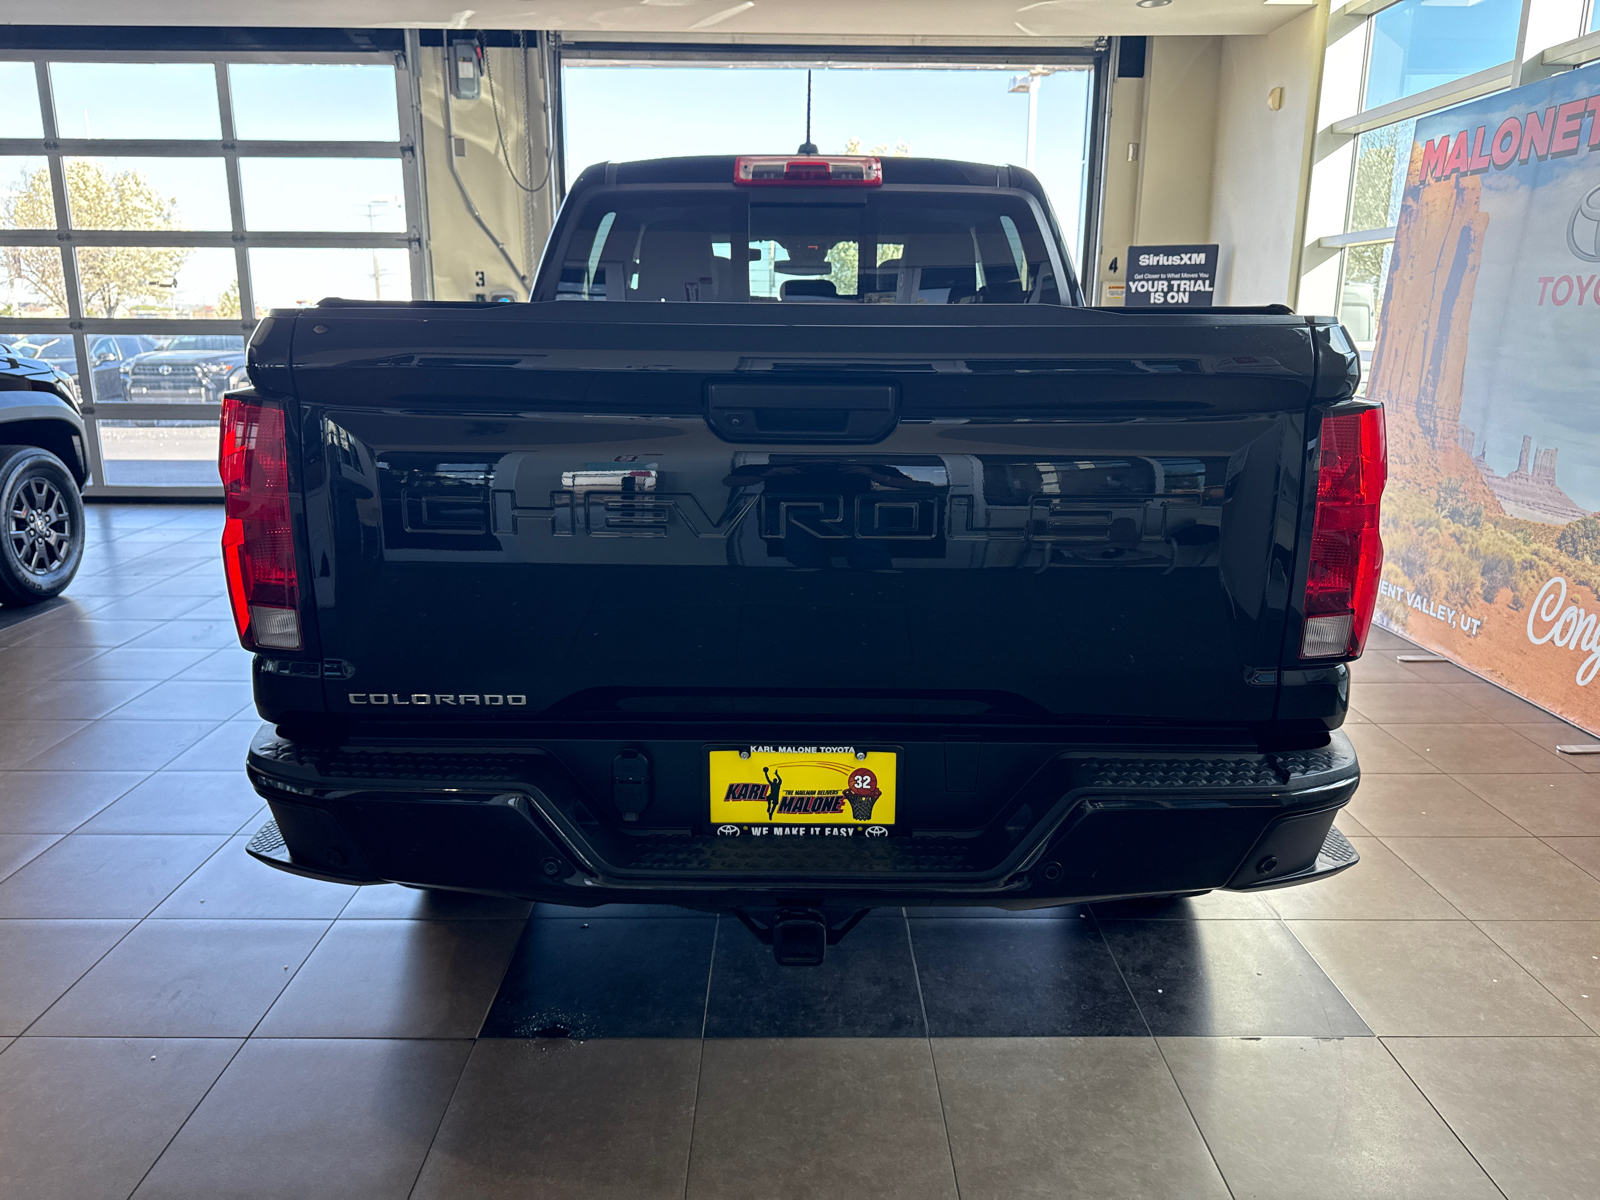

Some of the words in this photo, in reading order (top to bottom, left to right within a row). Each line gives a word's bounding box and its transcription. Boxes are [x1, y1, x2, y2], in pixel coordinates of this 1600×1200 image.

[1108, 256, 1118, 273] 4
[1139, 253, 1206, 266] SiriusXM
[475, 271, 485, 287] 3
[1128, 280, 1168, 293] YOUR
[1170, 280, 1214, 292] TRIAL
[1150, 292, 1164, 304] IS
[1166, 291, 1189, 304] ON
[401, 489, 1201, 542] CHEVROLET
[1379, 579, 1404, 602] ENT
[1406, 590, 1457, 629] VALLEY,
[1460, 613, 1481, 636] UT
[349, 693, 527, 706] COLORADO
[750, 745, 776, 753] KARL
[778, 746, 817, 754] MALONE
[819, 746, 855, 754] TOYOTA
[854, 775, 871, 789] 32
[724, 783, 770, 802] KARL
[777, 795, 846, 814] MALONE
[751, 826, 769, 837] WE
[773, 827, 806, 837] MAKE
[810, 827, 821, 836] IT
[824, 827, 854, 837] EASY
